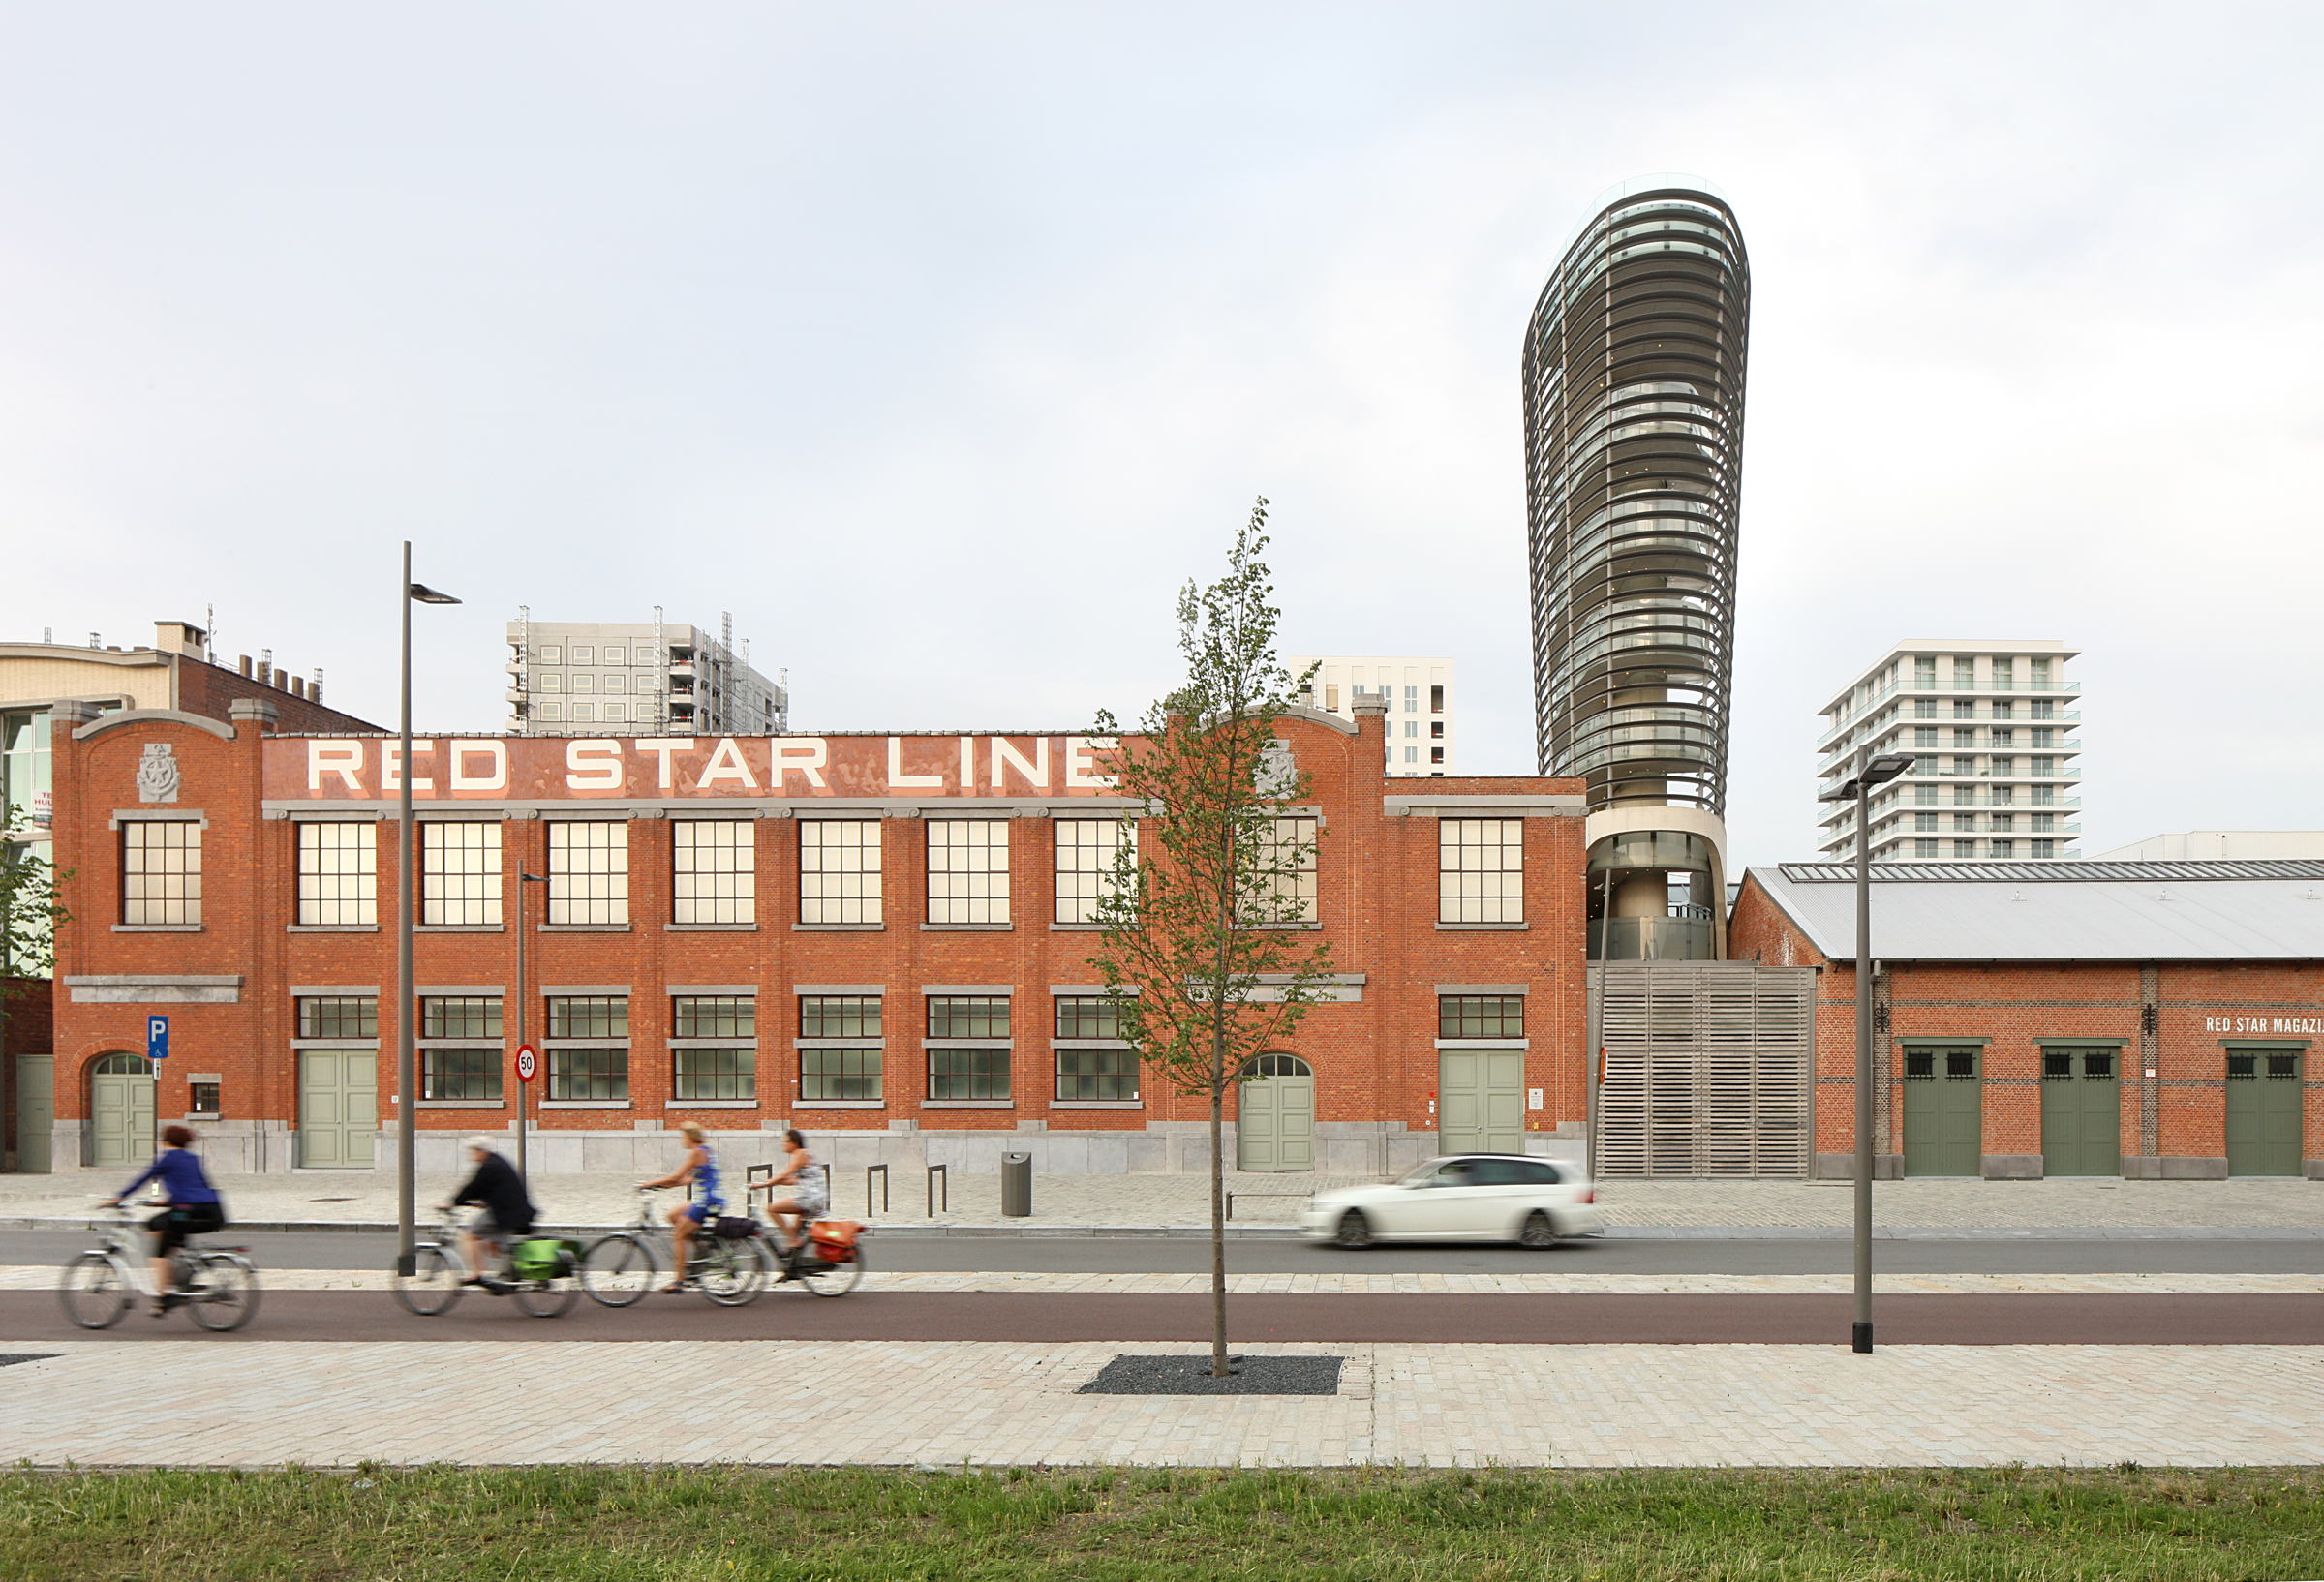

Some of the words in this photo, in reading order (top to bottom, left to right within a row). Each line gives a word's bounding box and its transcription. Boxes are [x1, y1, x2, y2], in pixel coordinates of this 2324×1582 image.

[307, 739, 507, 791] RED
[566, 737, 829, 791] STAR
[887, 737, 1120, 788] LINE
[151, 1020, 166, 1042] P
[2206, 1017, 2231, 1032] RED
[2236, 1018, 2268, 1033] STAR
[2273, 1018, 2324, 1034] MAGAZI
[521, 1056, 533, 1070] 50
